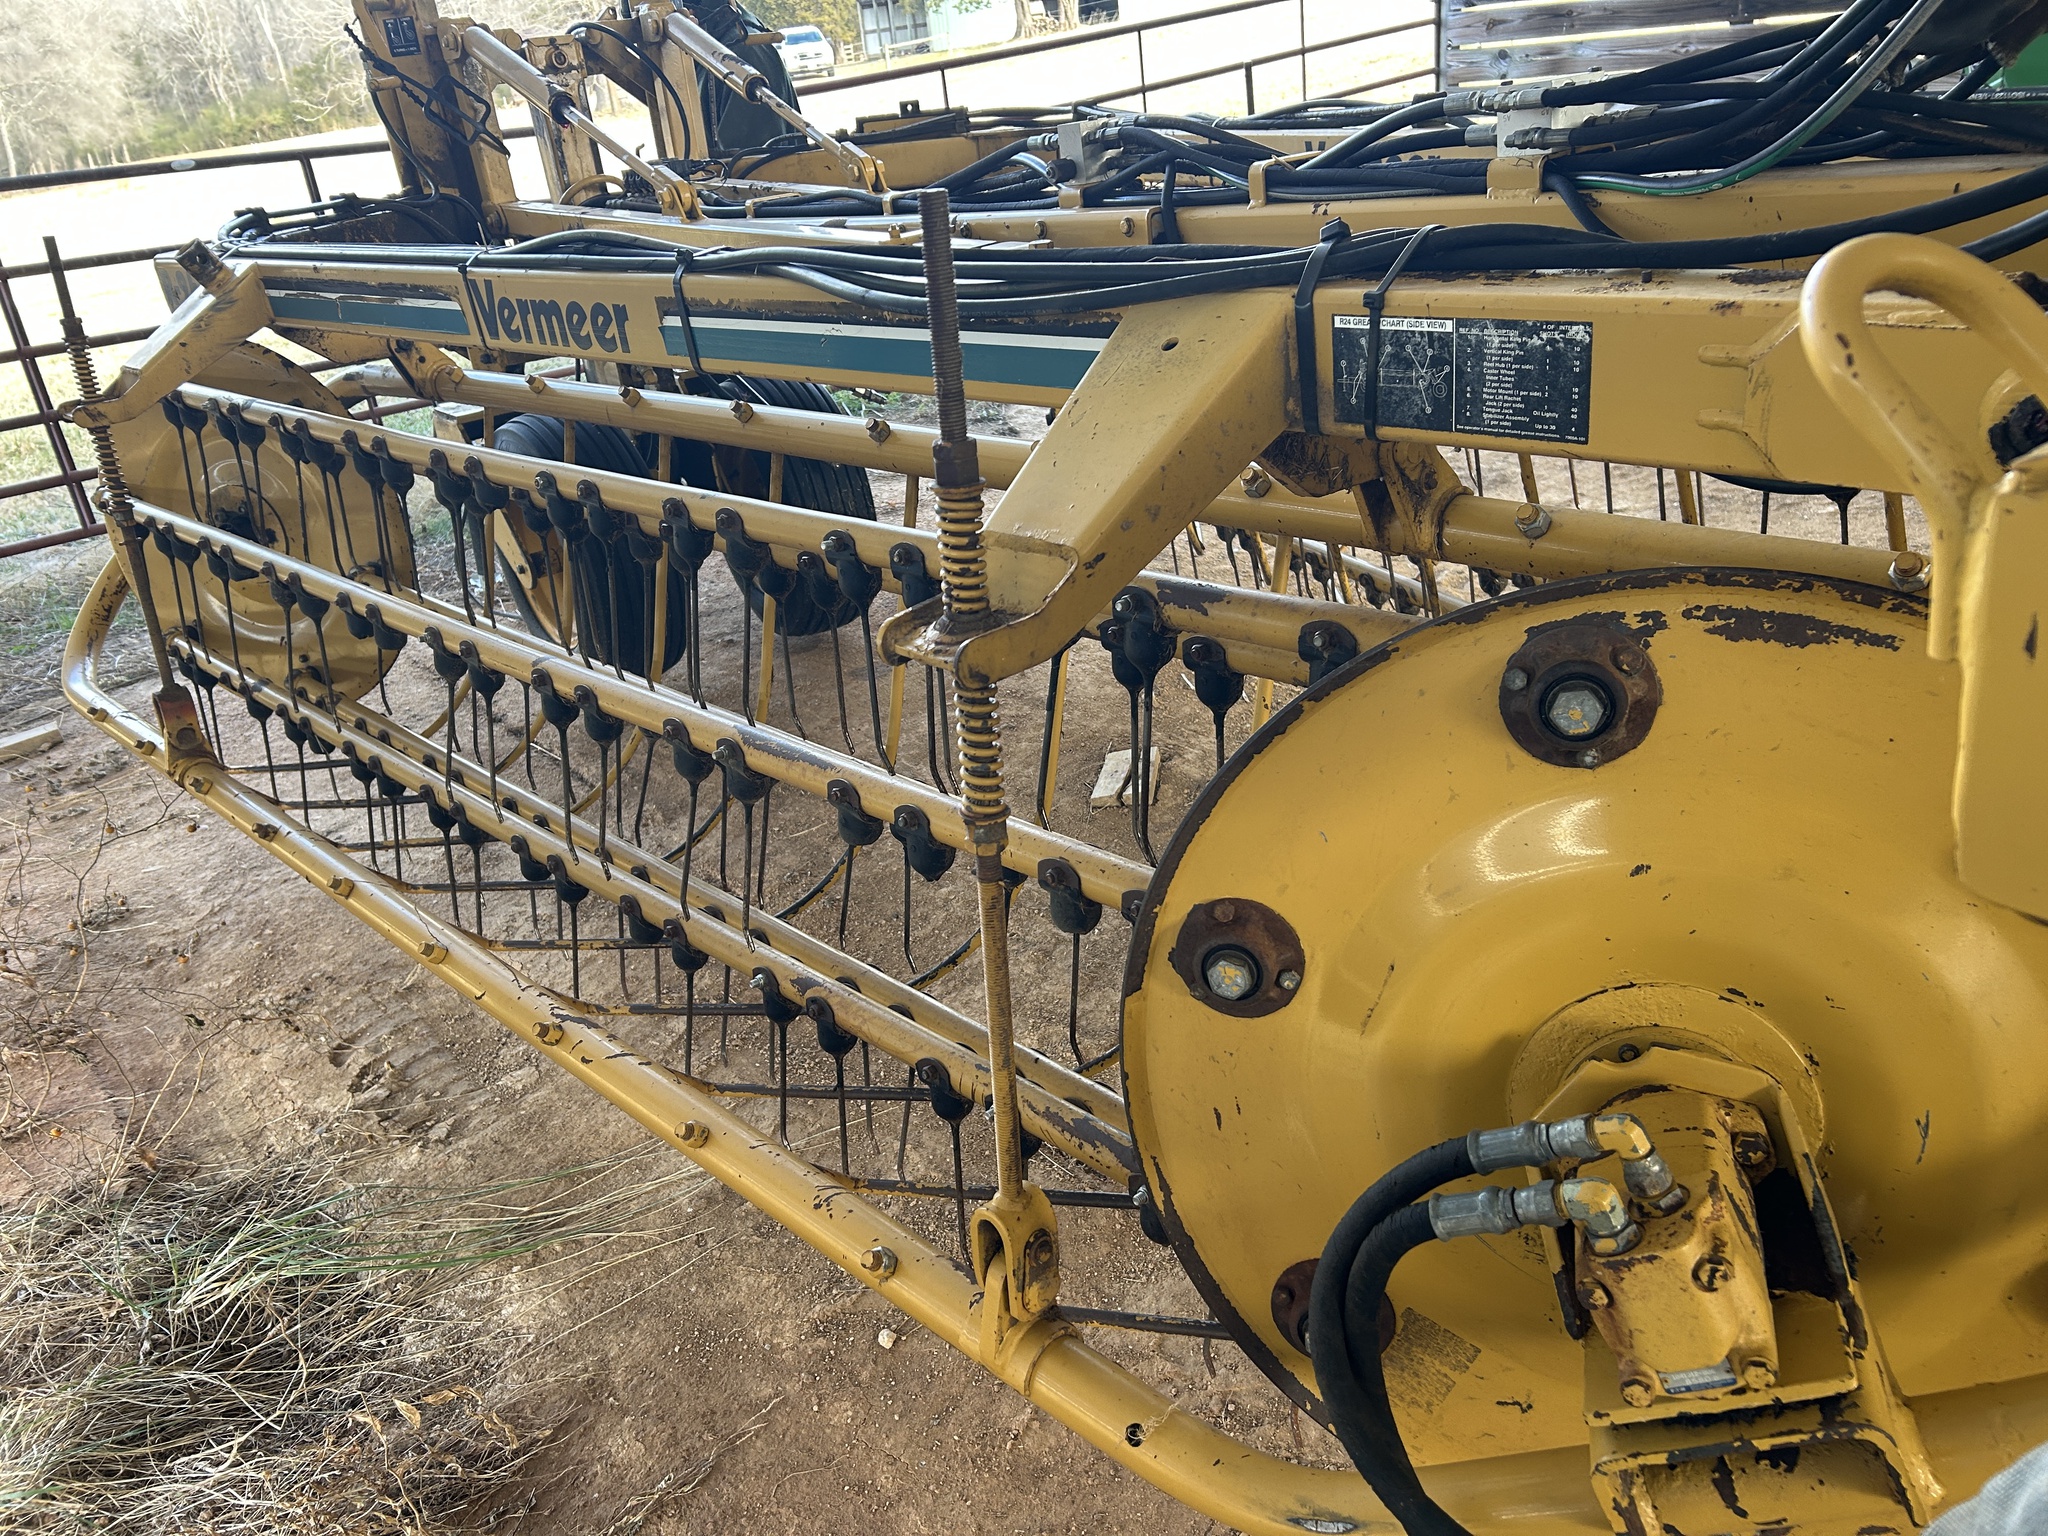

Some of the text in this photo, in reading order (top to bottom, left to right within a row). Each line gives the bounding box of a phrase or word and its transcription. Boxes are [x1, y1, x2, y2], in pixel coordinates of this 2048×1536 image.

[468, 278, 631, 354] Vermeer
[1381, 319, 1404, 327] CHART
[1406, 320, 1425, 329] (SIDE
[1426, 321, 1446, 330] VIEW)
